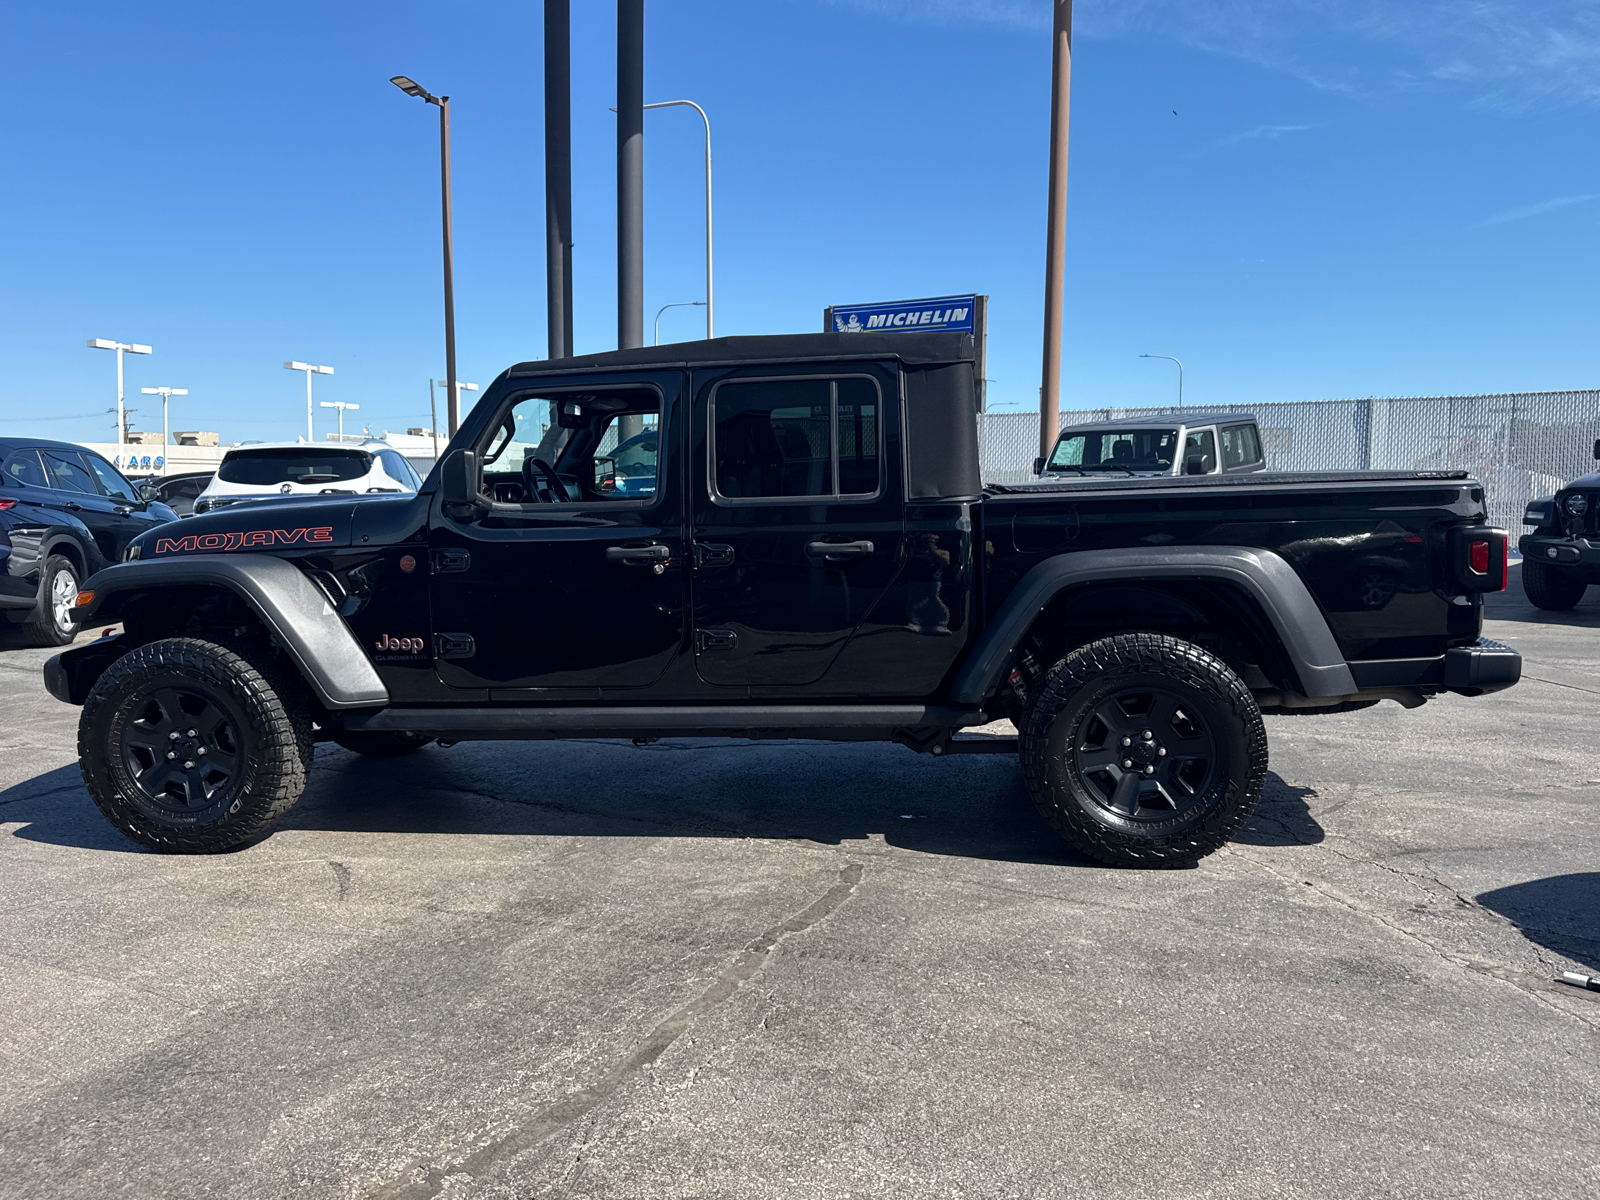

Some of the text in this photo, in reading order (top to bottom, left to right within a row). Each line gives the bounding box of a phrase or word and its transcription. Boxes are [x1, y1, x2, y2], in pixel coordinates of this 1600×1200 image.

[866, 308, 969, 328] MICHELIN
[155, 526, 333, 553] MOJAVE
[375, 633, 424, 655] Jeep
